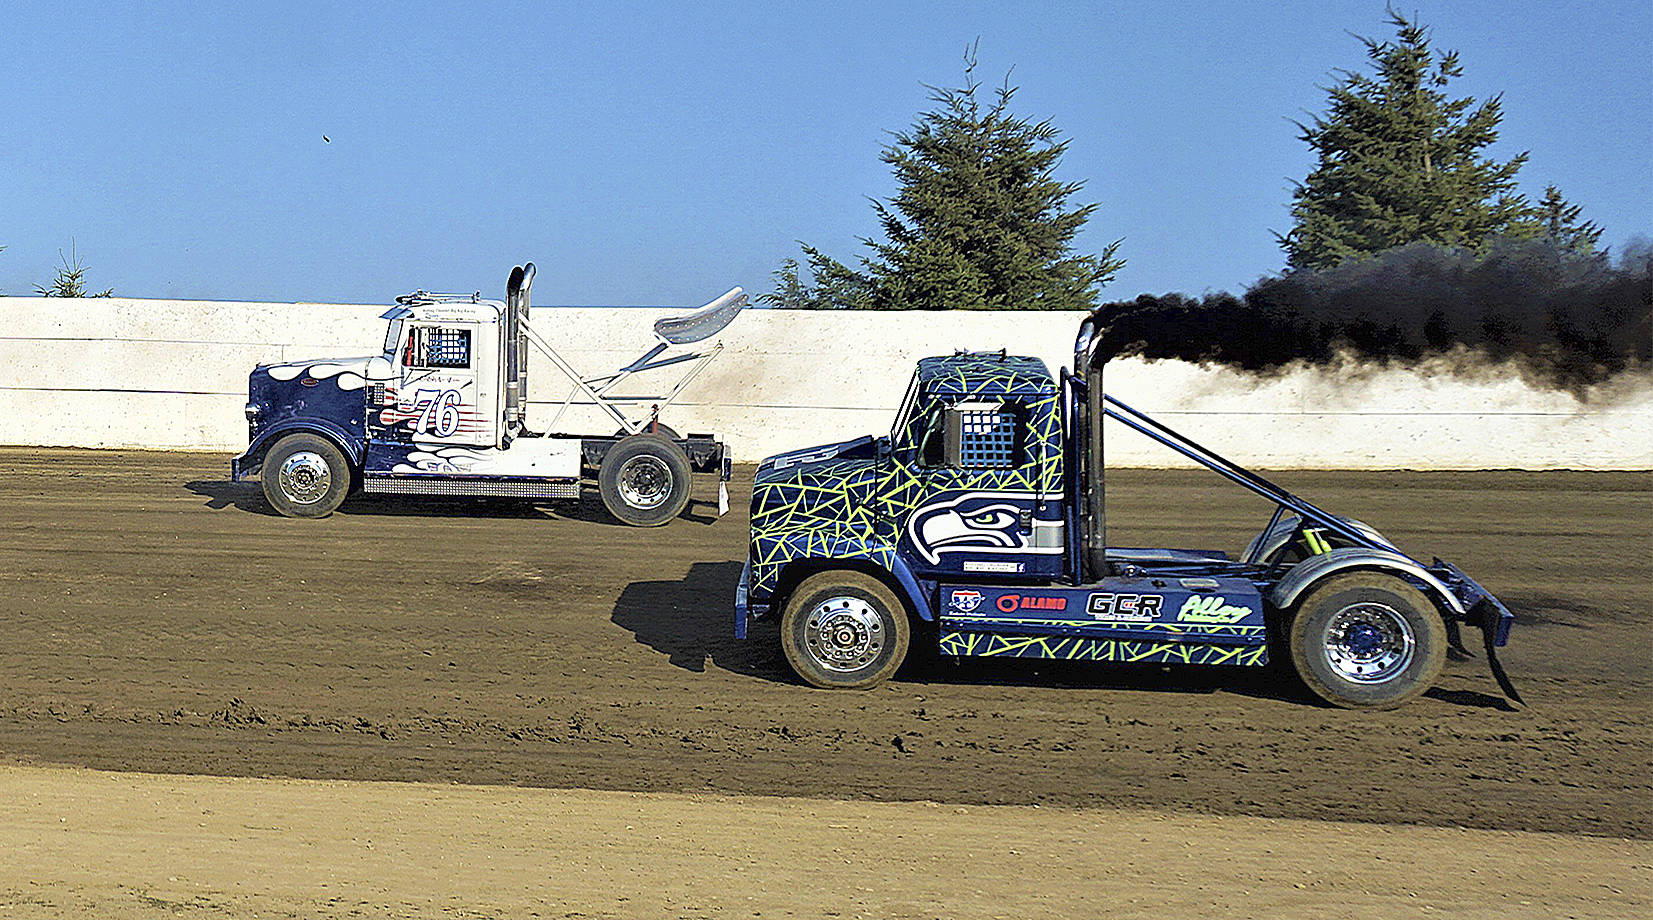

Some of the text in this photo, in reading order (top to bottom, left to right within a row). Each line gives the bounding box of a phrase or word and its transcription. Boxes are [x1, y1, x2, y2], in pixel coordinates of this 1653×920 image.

[414, 388, 462, 438] 76
[1020, 596, 1067, 610] ALAMO
[1086, 592, 1164, 618] GCR
